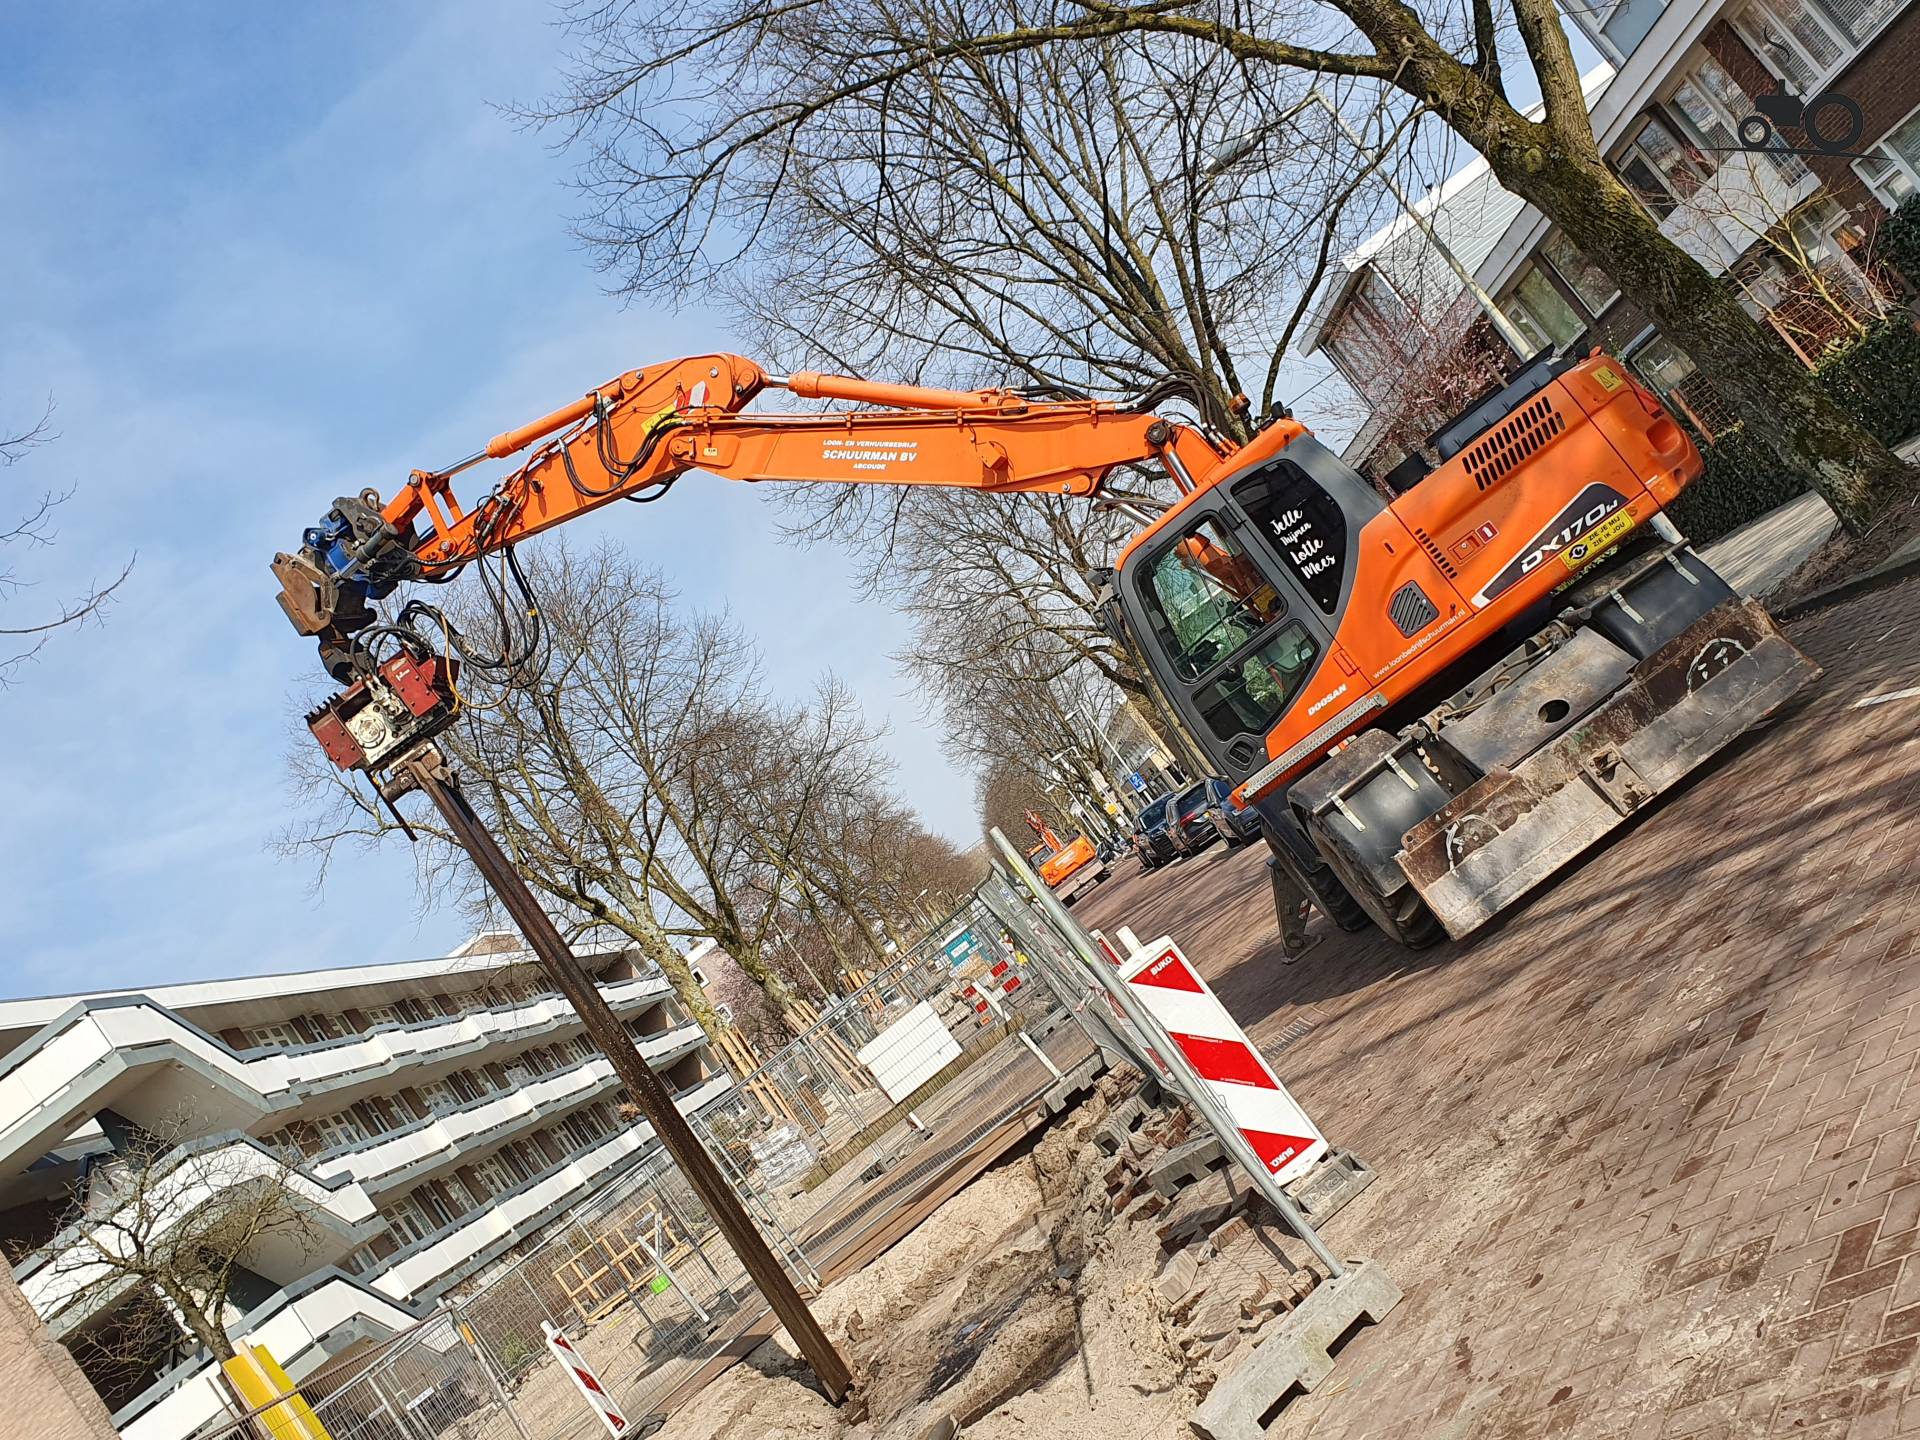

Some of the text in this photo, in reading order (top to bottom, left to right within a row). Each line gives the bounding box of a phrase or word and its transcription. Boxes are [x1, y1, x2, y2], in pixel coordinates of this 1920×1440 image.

[822, 449, 917, 462] SCHUURMAN BV
[1269, 509, 1303, 535] Jelle
[1587, 515, 1621, 541] ZIE JE MIJ
[1592, 521, 1626, 548] ZIE IK JOU
[1289, 539, 1324, 565] Lotte
[1300, 555, 1336, 580] Mees
[1307, 683, 1348, 716] DOOSAN
[1150, 955, 1174, 976] BUKO
[1270, 1146, 1295, 1167] BUKO
